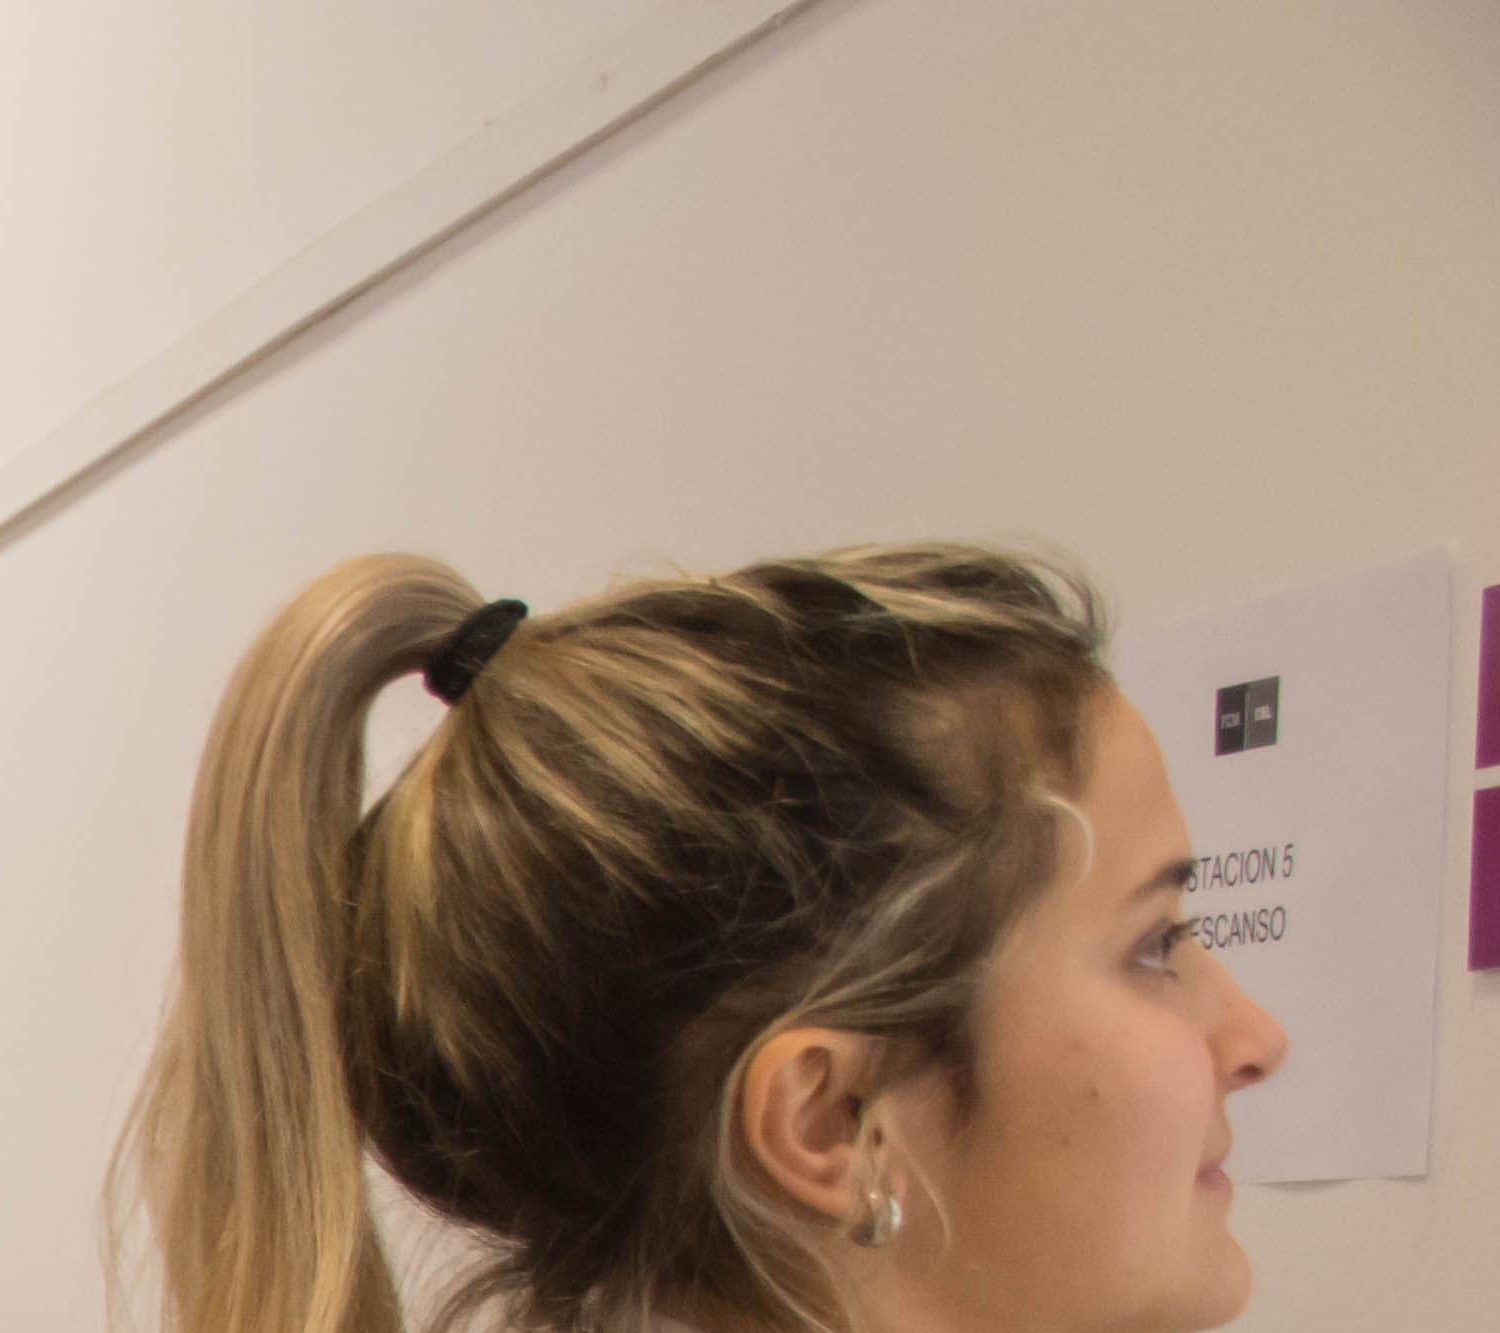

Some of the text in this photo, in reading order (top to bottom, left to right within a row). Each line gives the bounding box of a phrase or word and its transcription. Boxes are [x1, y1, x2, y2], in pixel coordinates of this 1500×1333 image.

[1186, 843, 1294, 892] STACION 5
[1189, 905, 1286, 950] SCANSO
